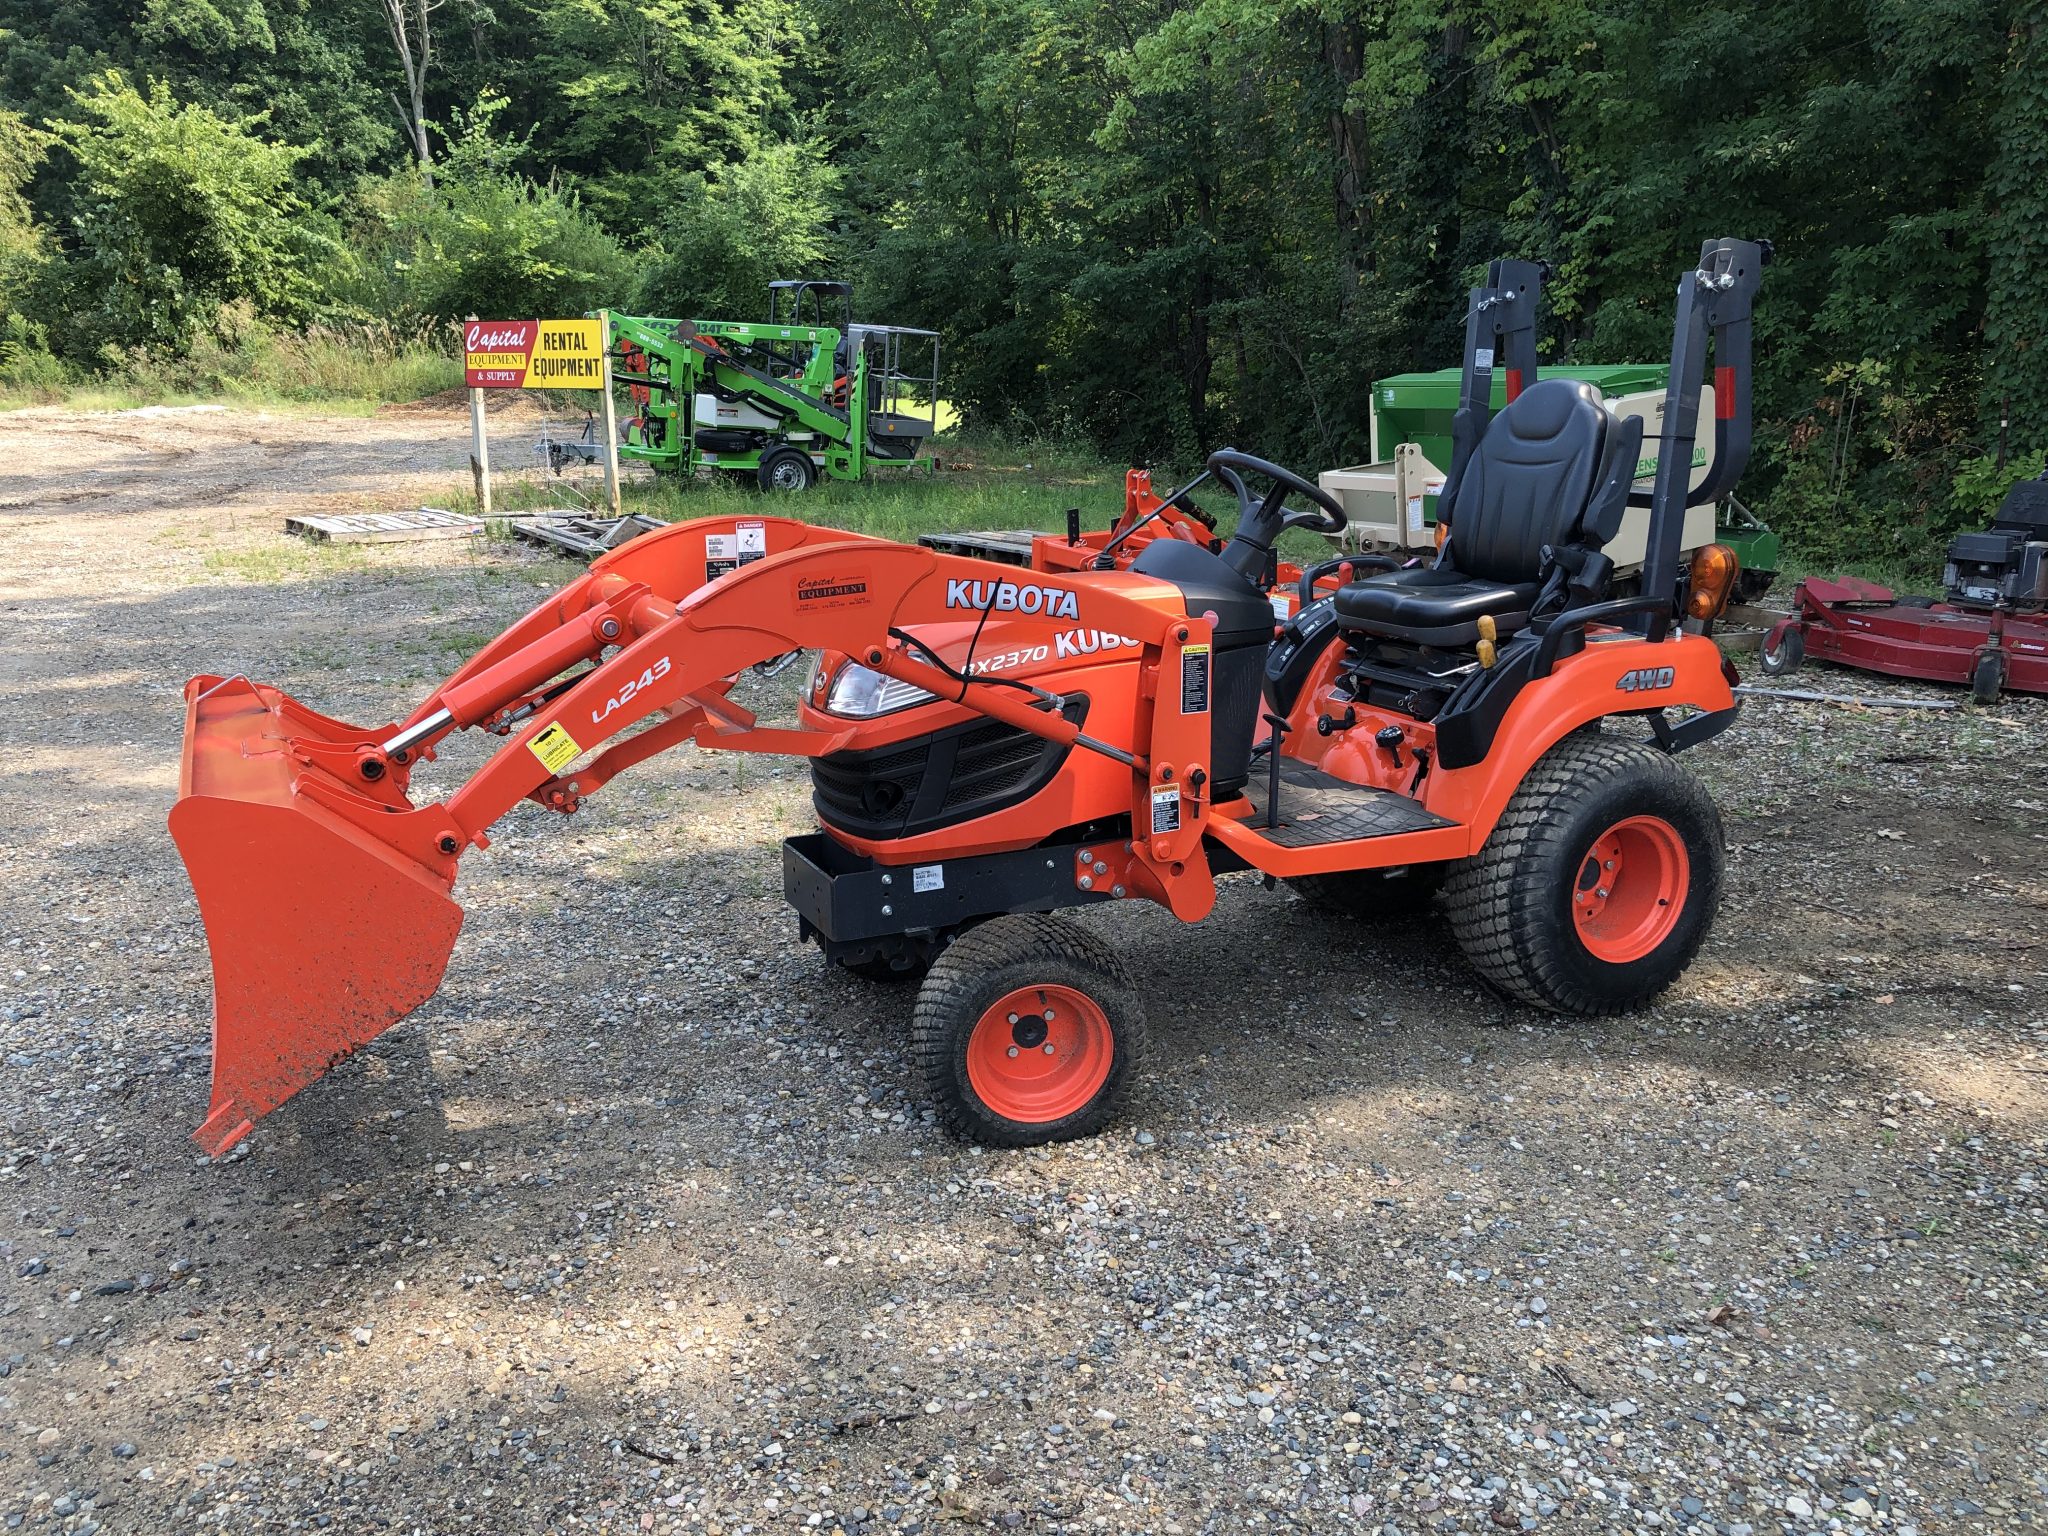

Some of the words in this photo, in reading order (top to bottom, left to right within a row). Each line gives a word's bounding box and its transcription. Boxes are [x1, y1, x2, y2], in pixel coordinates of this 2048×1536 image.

[467, 325, 526, 351] Capital
[543, 332, 588, 350] RENTAL
[469, 354, 524, 367] EQUIPMENT
[533, 358, 600, 379] EQUIPMENT
[477, 371, 484, 380] &
[486, 371, 516, 381] SUPPLY
[798, 576, 835, 589] Capital
[800, 584, 865, 599] EQUIPMENT
[946, 579, 1080, 621] KUBOTA
[591, 656, 672, 724] LA243
[1616, 666, 1675, 693] 4WD
[542, 738, 570, 761] LUBRICATE
